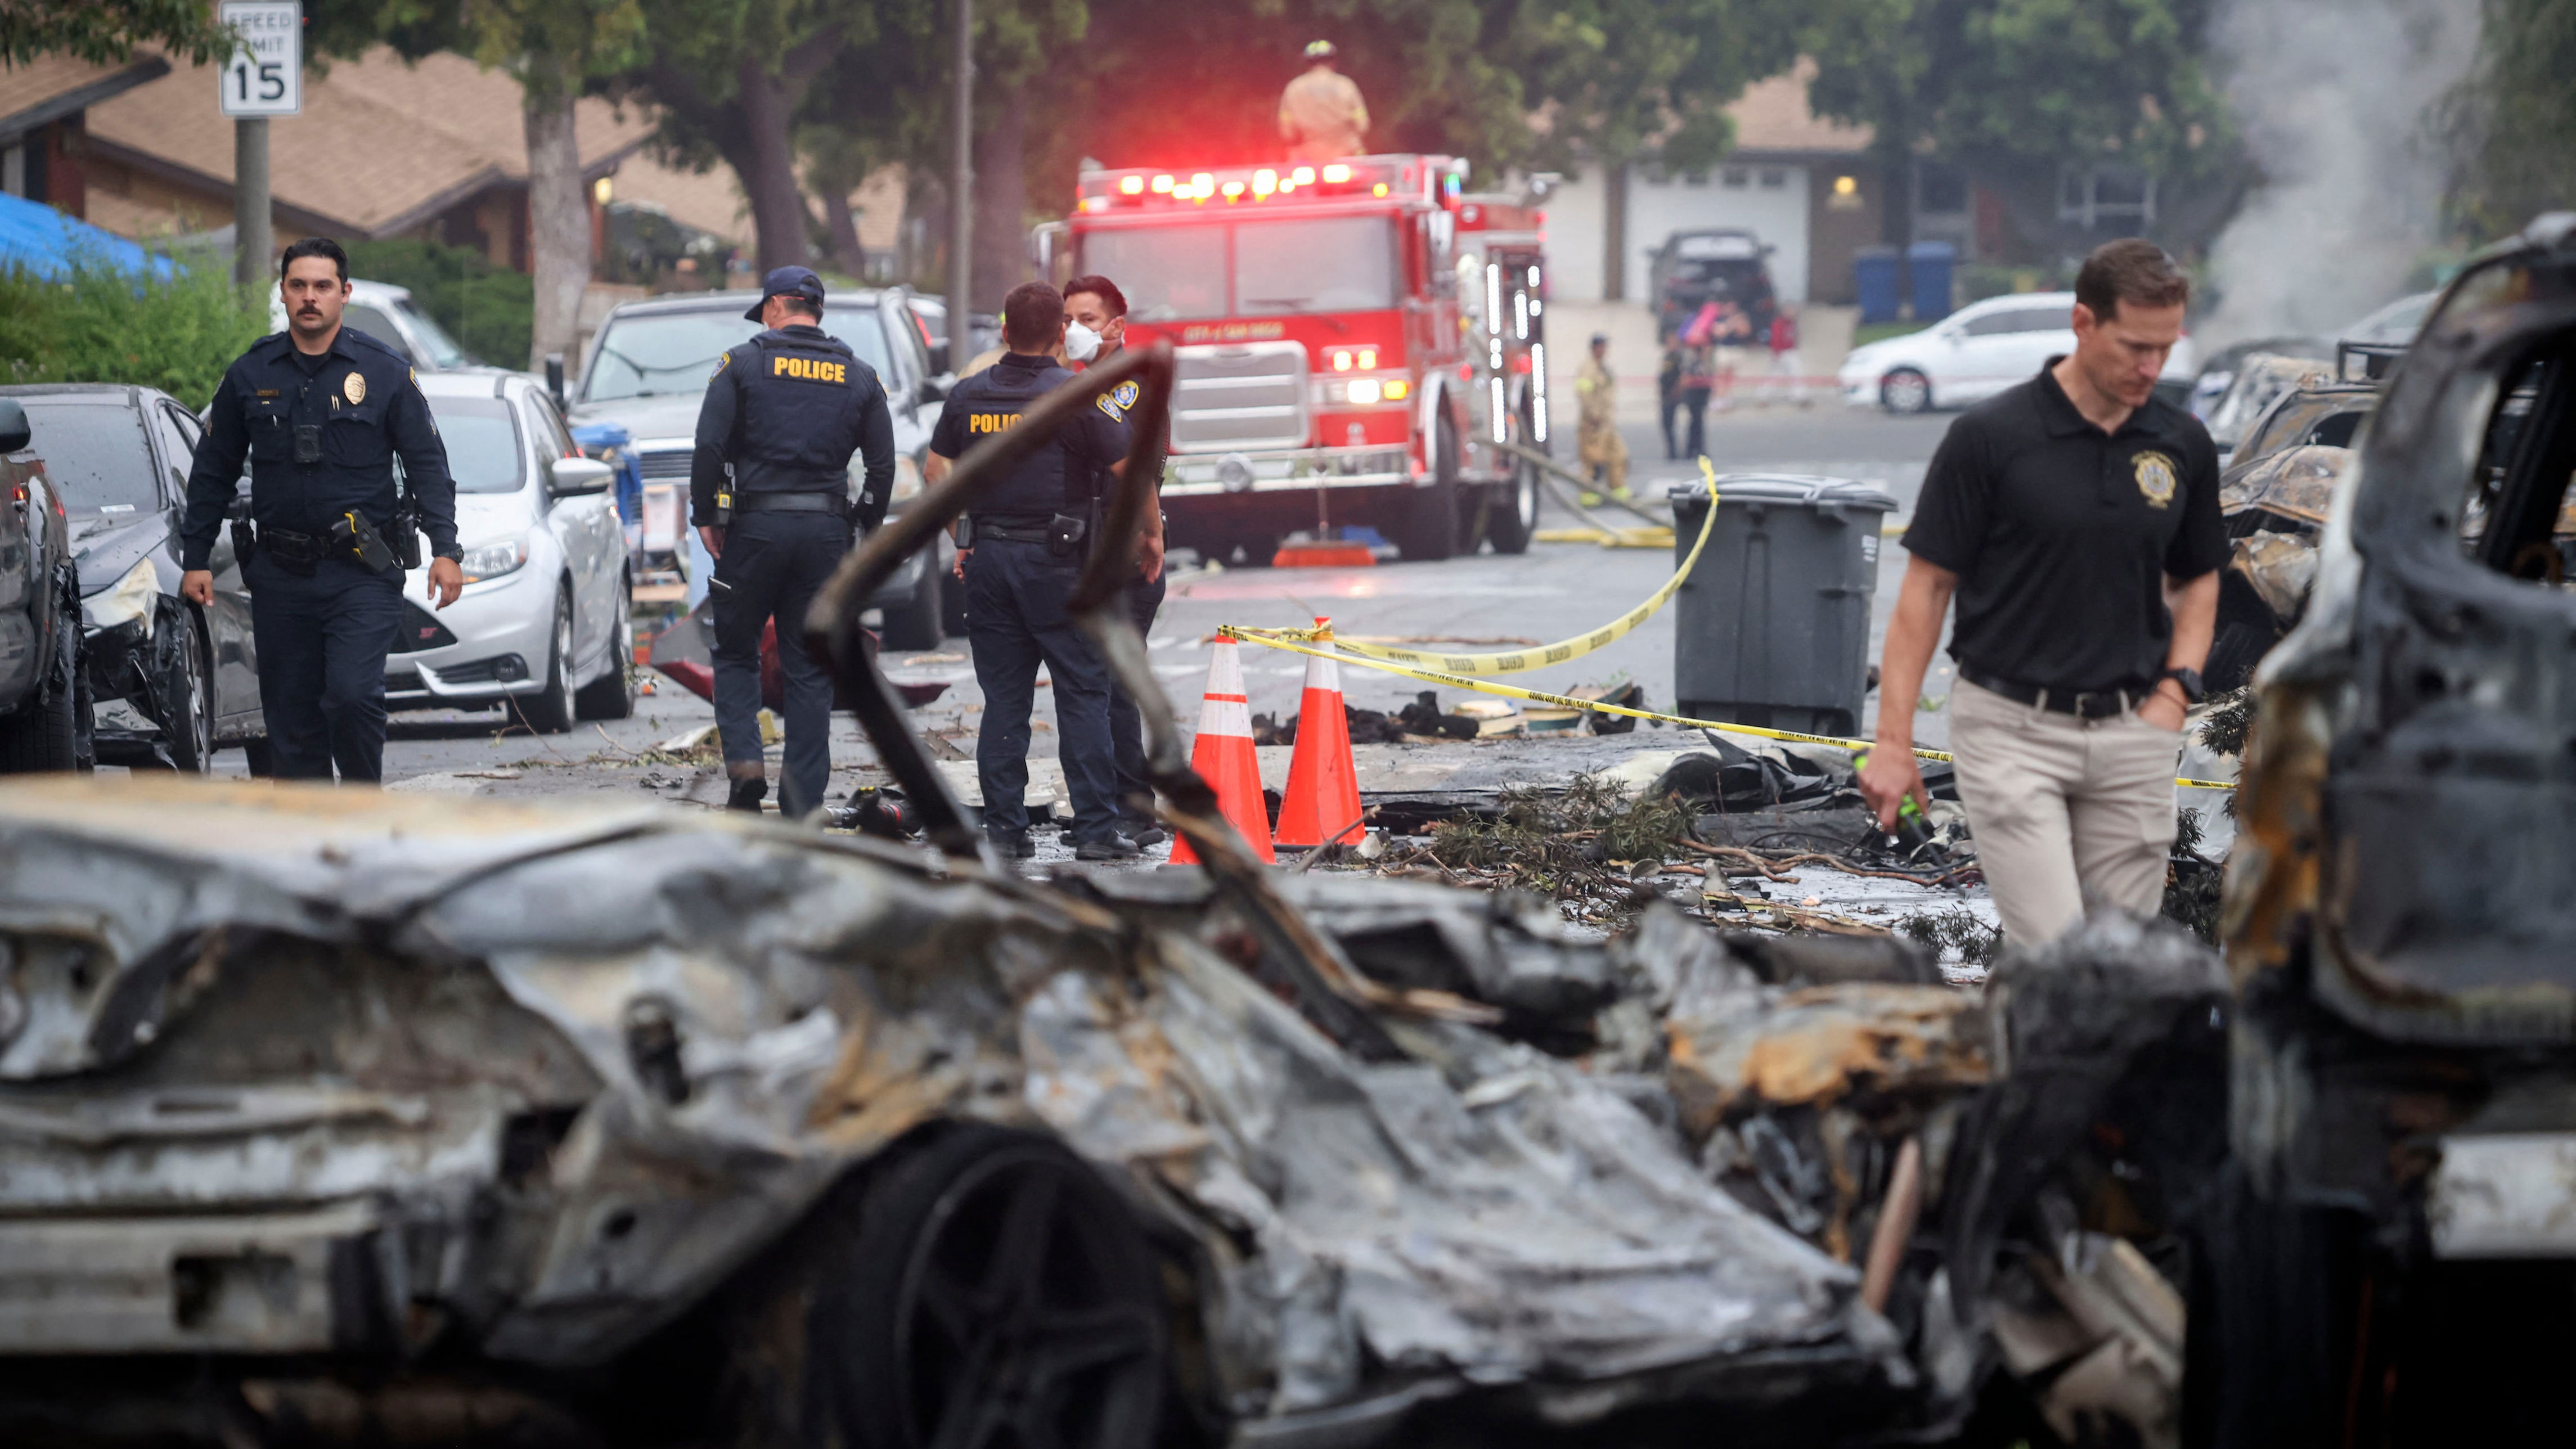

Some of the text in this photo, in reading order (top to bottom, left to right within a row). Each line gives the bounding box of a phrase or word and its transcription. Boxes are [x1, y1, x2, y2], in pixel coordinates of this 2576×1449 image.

[236, 63, 285, 101] 15
[774, 357, 845, 383] POLICE
[970, 413, 1029, 433] POLIC
